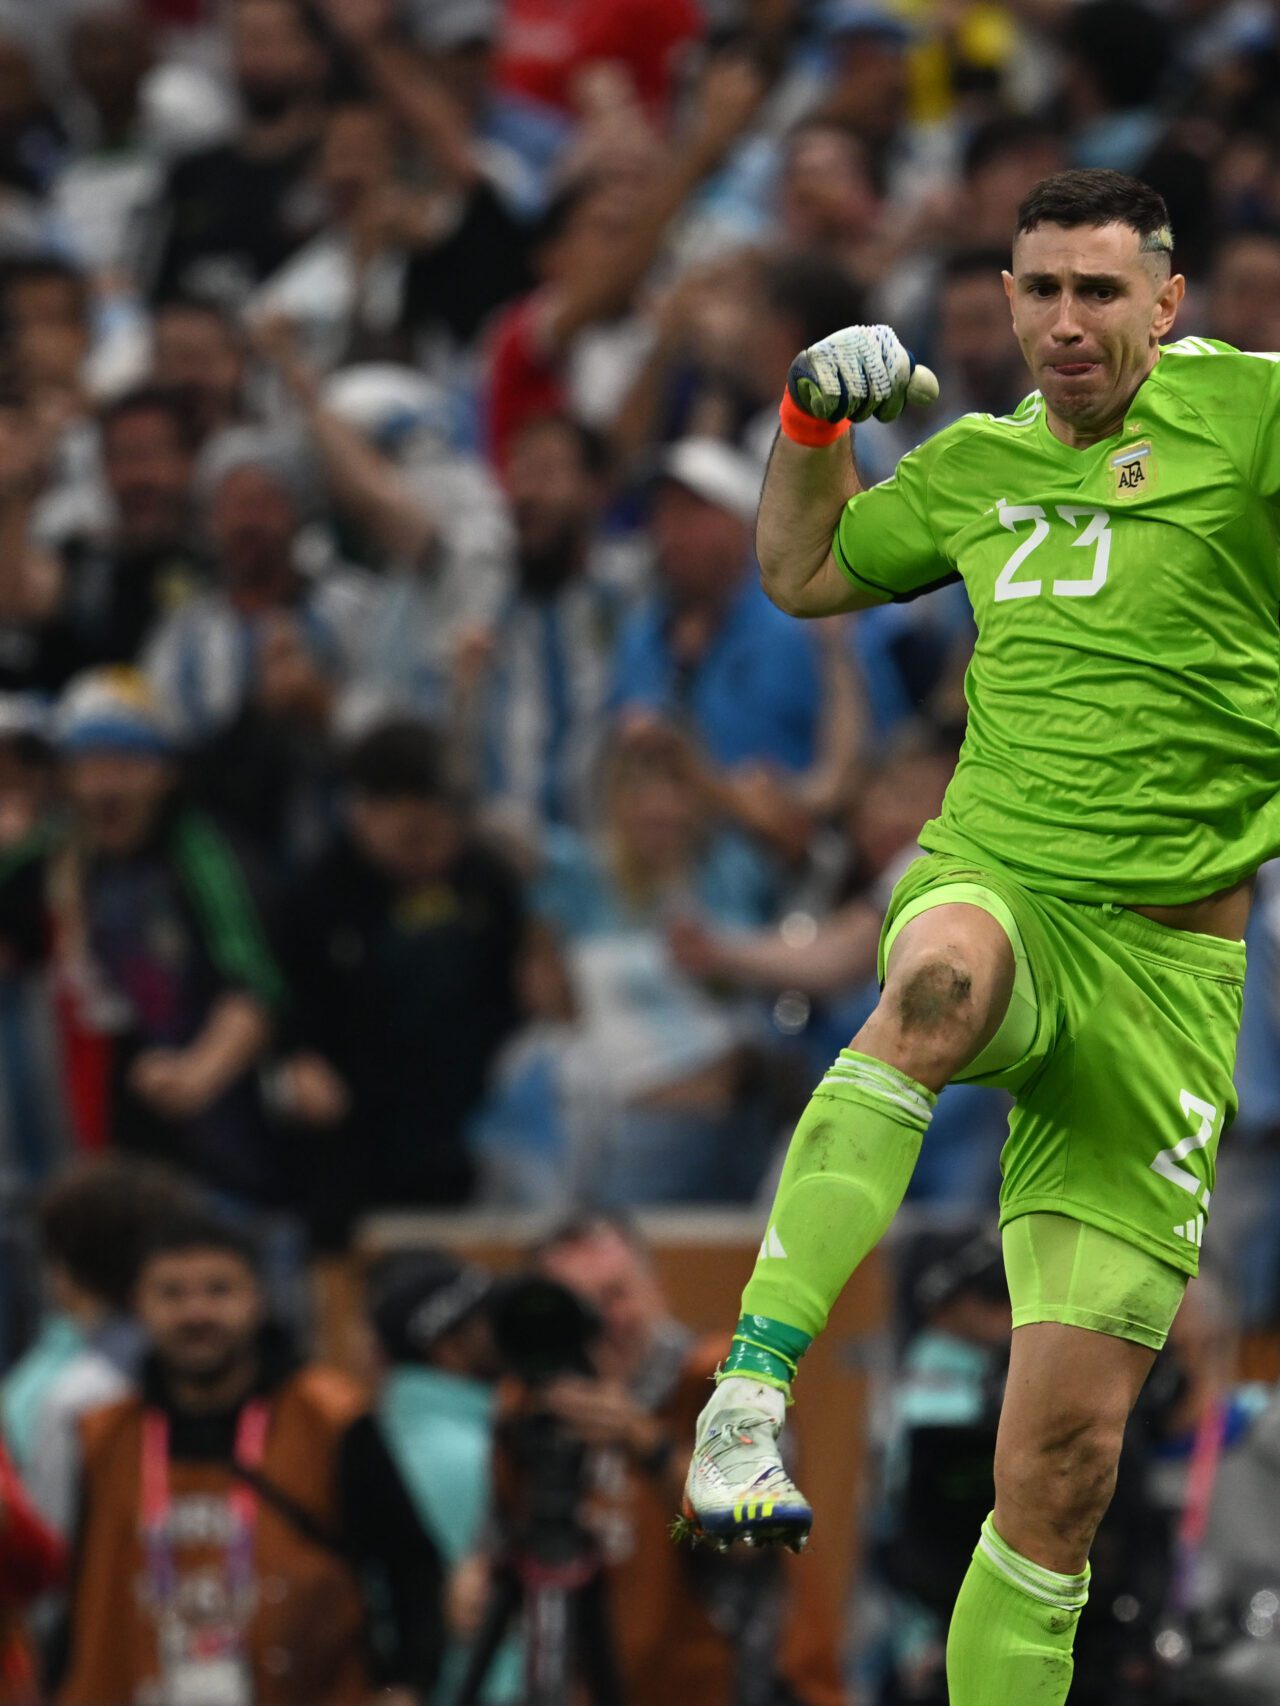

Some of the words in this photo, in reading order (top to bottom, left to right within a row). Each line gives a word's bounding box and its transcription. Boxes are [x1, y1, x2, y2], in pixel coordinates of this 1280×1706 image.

[1118, 460, 1145, 488] AFA
[994, 504, 1112, 603] 23
[1150, 1088, 1224, 1205] 2
